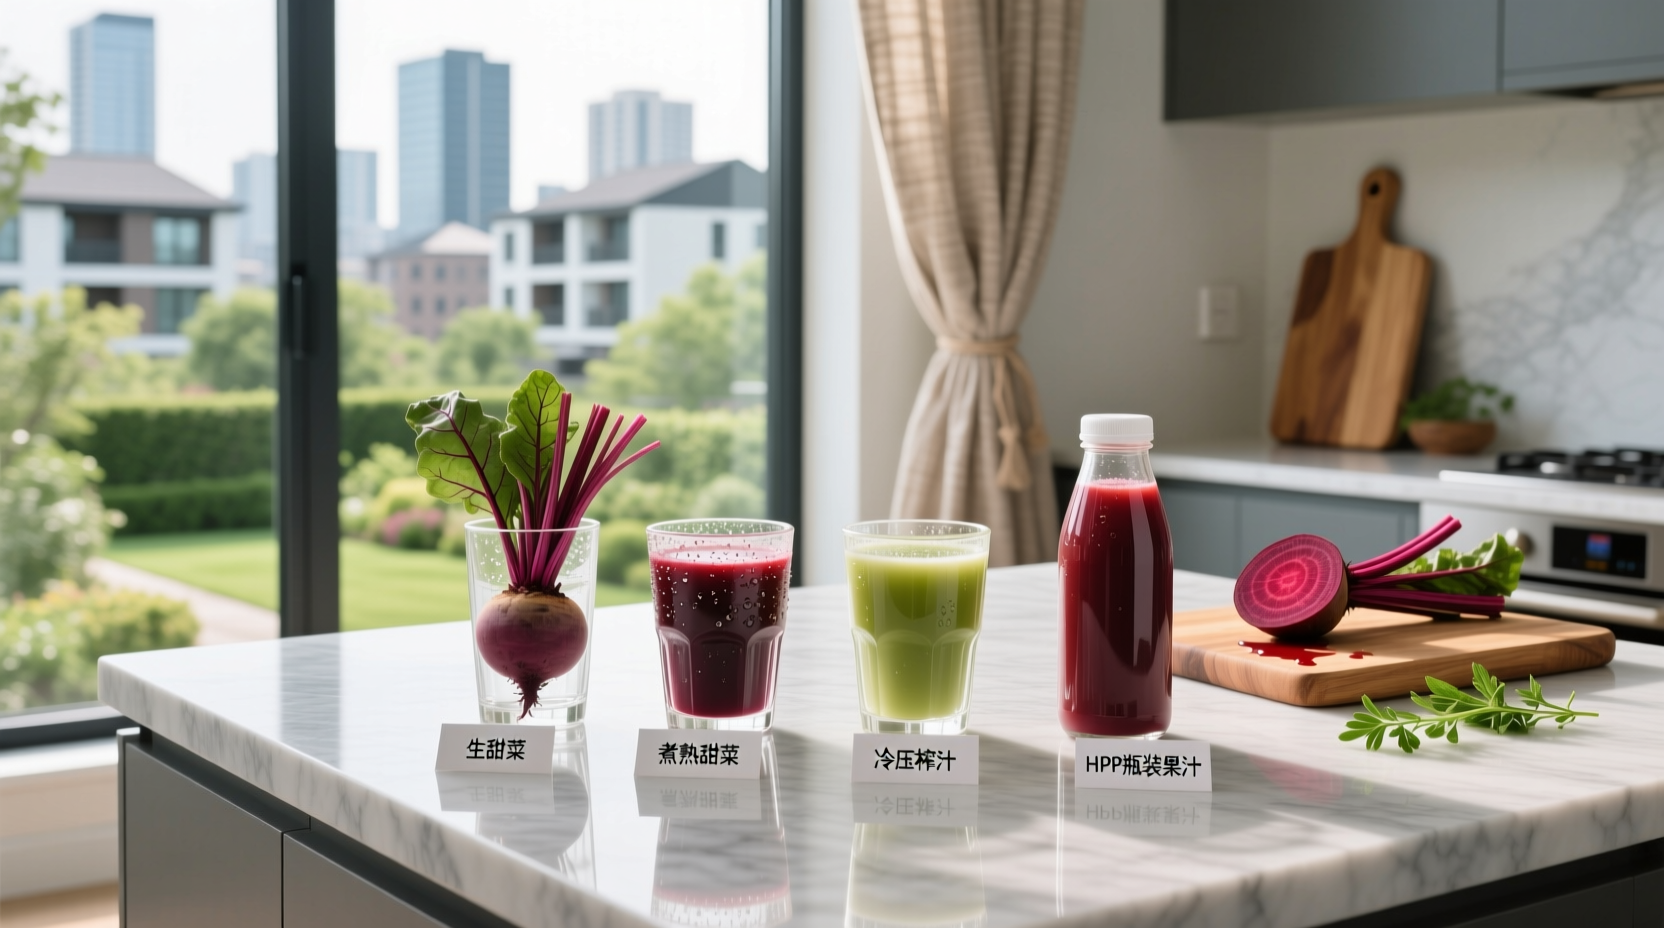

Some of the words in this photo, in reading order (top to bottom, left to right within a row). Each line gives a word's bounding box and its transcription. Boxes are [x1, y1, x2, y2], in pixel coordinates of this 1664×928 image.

[466, 737, 526, 760] 生甜菜
[658, 742, 740, 766] 煮熟甜菜
[874, 747, 956, 771] 冷压榨汁
[1086, 754, 1202, 777] HPP瓶装果汁
